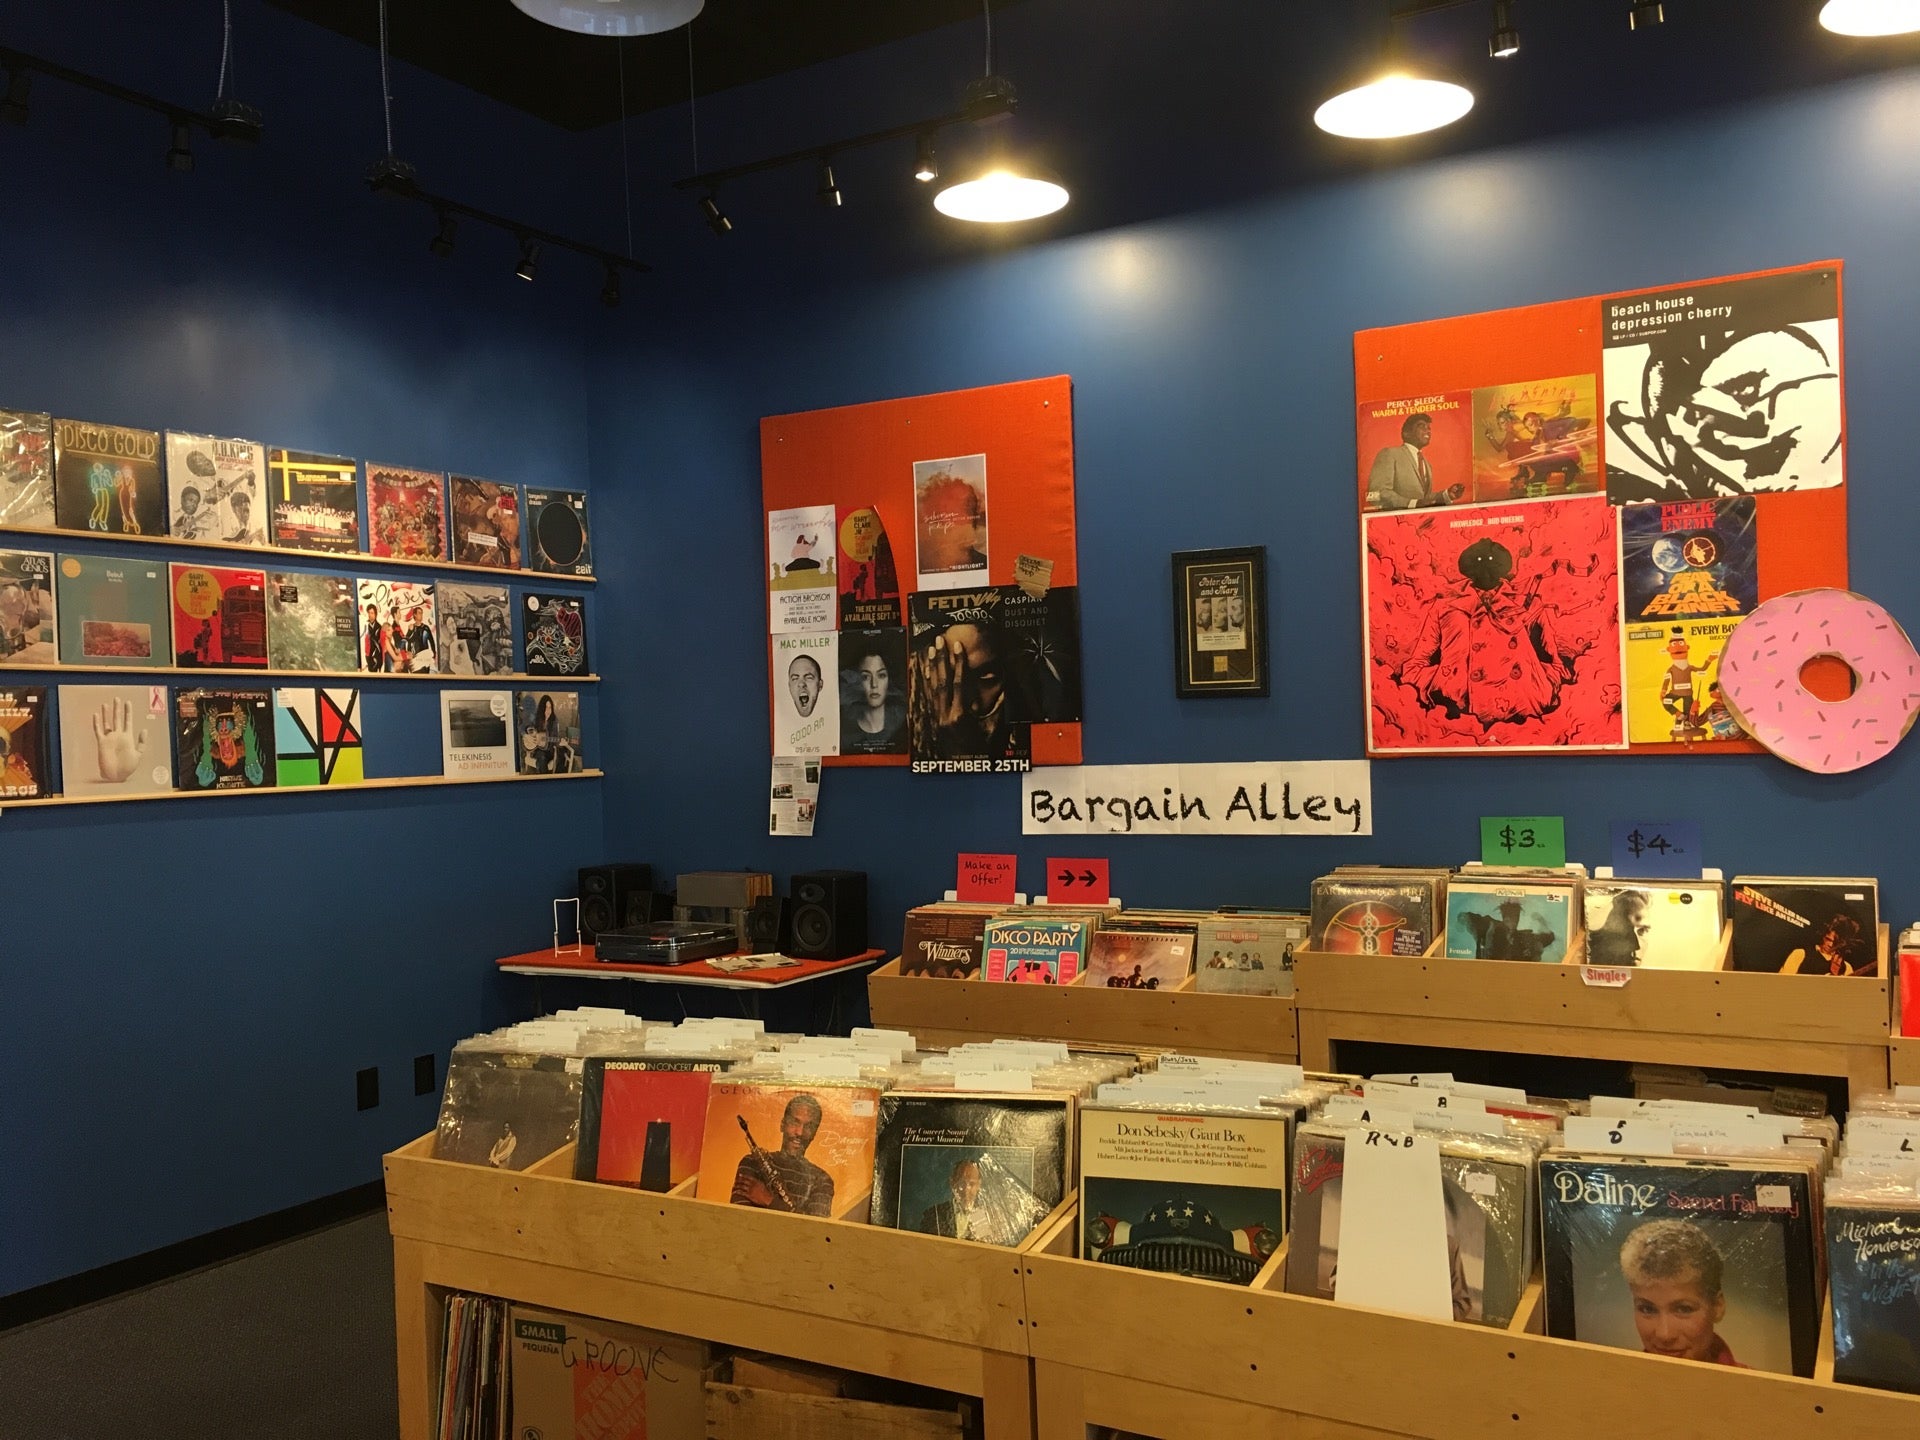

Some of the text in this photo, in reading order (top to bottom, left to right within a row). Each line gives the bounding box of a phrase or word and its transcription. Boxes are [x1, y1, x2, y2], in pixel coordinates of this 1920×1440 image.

[1611, 296, 1694, 317] beach house
[1611, 306, 1732, 331] depression cherry
[1371, 408, 1397, 418] WARM
[1405, 403, 1436, 415] TENDER
[1437, 400, 1460, 410] SOUL
[1387, 395, 1445, 409] PERCY SLEDGE
[64, 425, 109, 453] DISCO
[113, 432, 156, 458] GOLD
[1661, 501, 1716, 516] PUBLIC
[1661, 518, 1715, 532] ENEMY
[20, 563, 49, 575] GENIUS
[23, 557, 46, 567] ATLAS
[928, 595, 981, 610] FETTY
[1650, 591, 1740, 605] BLACK
[1004, 606, 1048, 617] DUST AND
[1640, 603, 1740, 615] PLANET
[1004, 618, 1046, 628] DISQUIET
[1691, 625, 1718, 636] EVERY
[780, 637, 830, 649] MAC MILLER
[449, 753, 492, 761] TELEKINESIS
[912, 759, 1030, 773] SEPTEMBER 25TH
[1030, 782, 1361, 833] Bargain Alley
[964, 860, 1011, 871] Make an
[971, 873, 1002, 887] Offer!
[1734, 890, 1753, 906] FLY
[1743, 885, 1773, 908] STEVE
[992, 930, 1078, 947] DISCO PARTY
[919, 940, 973, 964] Winners
[1586, 968, 1628, 983] Singles
[605, 1062, 646, 1071] DEODATO
[656, 1063, 693, 1072] CONCERT
[693, 1064, 721, 1073] AIRTO
[1361, 1110, 1371, 1123] A
[904, 1127, 917, 1135] The
[1117, 1123, 1142, 1136] Don
[1223, 1129, 1246, 1143] Box
[1608, 1130, 1622, 1144] D
[1366, 1131, 1414, 1148] R B
[1900, 1138, 1914, 1152] L
[521, 1324, 558, 1341] SMALL
[522, 1342, 560, 1355] PEQUEÑA
[561, 1336, 679, 1383] GROOVE
